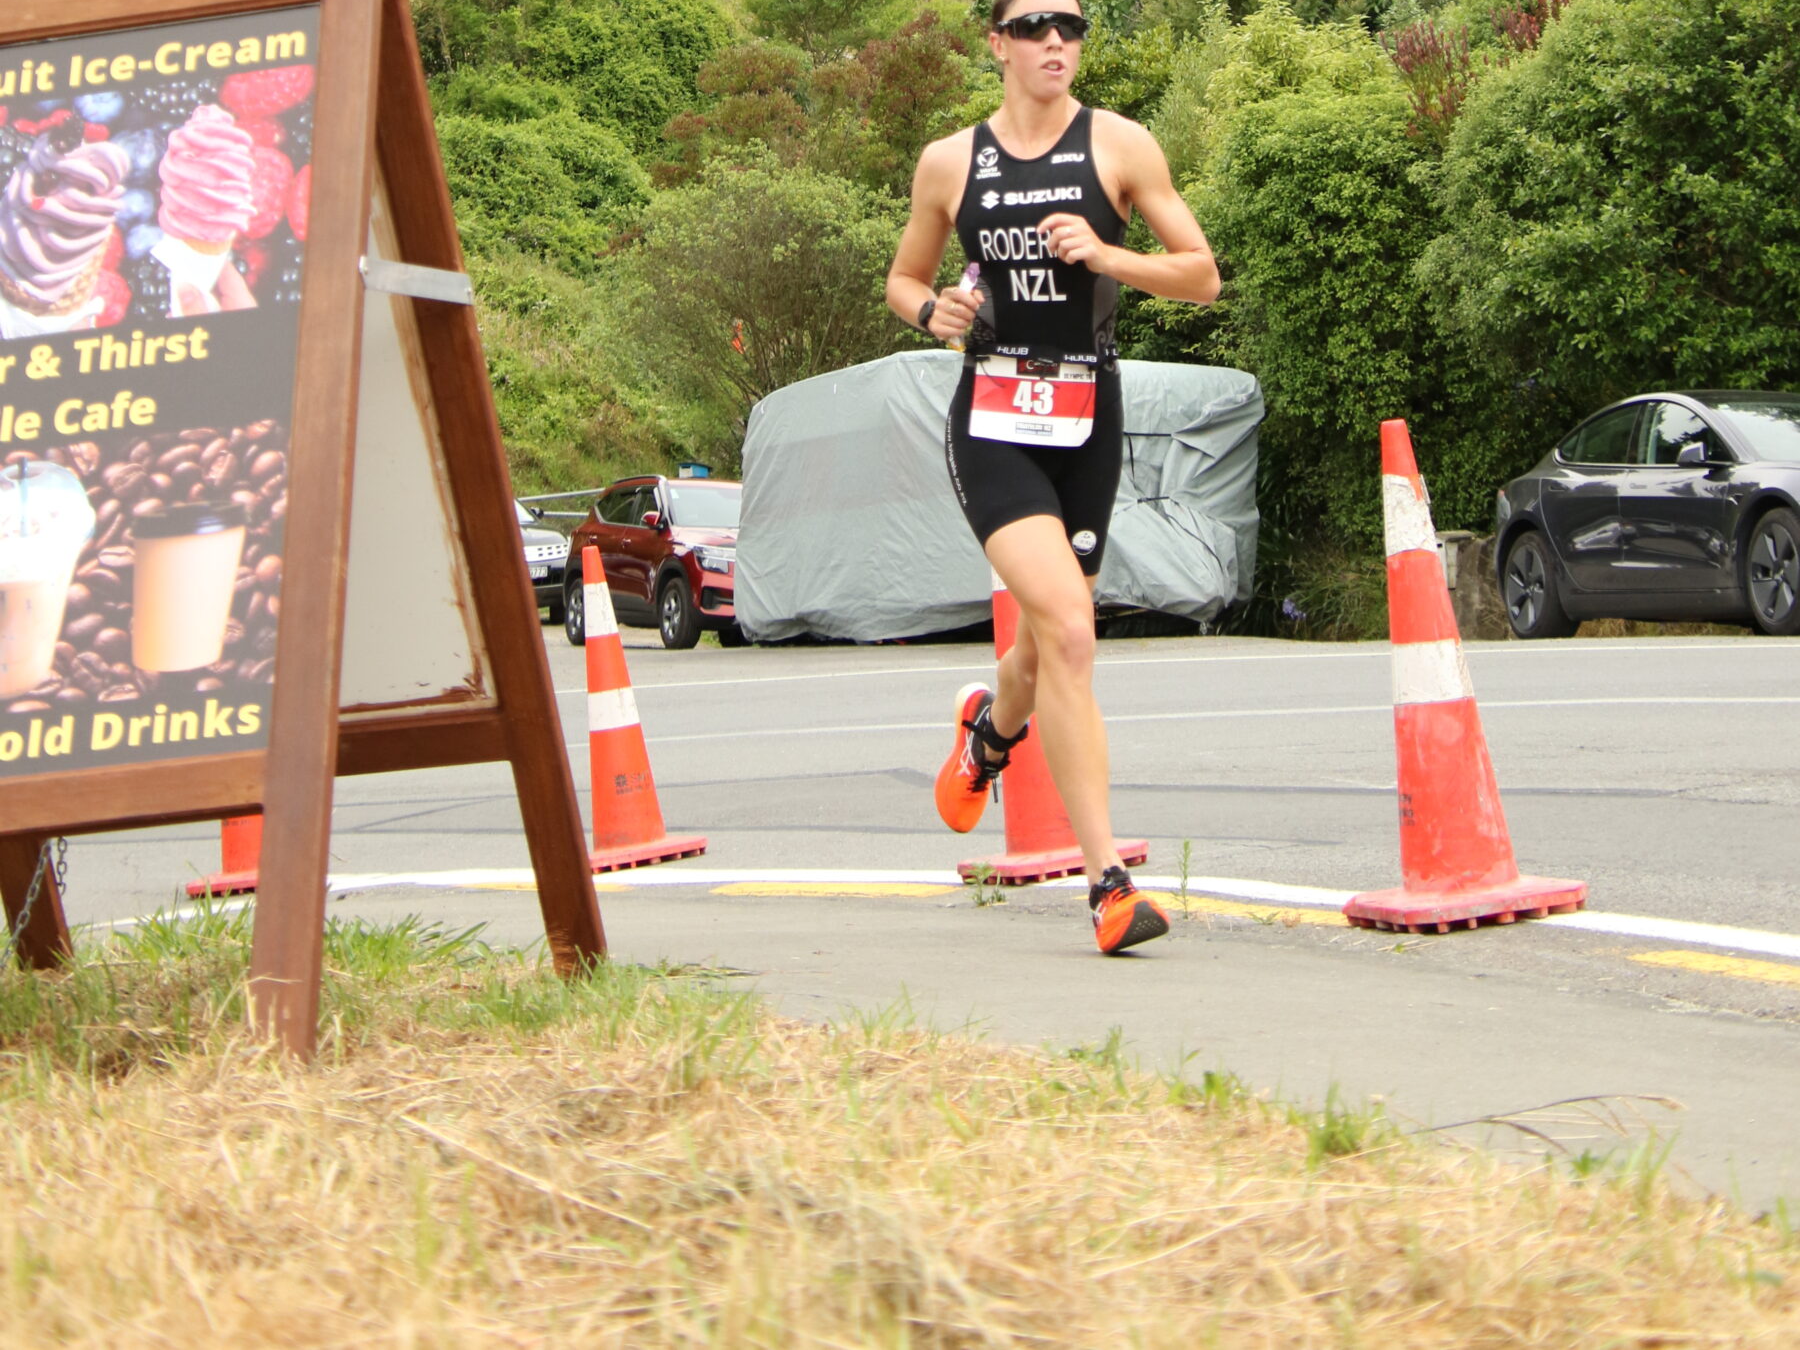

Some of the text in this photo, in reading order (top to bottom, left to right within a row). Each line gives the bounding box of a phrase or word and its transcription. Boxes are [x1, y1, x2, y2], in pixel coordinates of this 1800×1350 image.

[69, 30, 306, 87] Ice-Cream
[1052, 152, 1085, 164] 2XU
[1003, 186, 1083, 206] SUZUKI
[979, 226, 1060, 261] RODER
[1010, 268, 1067, 302] NZL
[25, 344, 61, 380] &
[74, 326, 210, 374] Thirst
[997, 346, 1029, 356] HUUB
[1064, 354, 1098, 364] HUUB
[53, 390, 157, 435] Cafe
[1013, 380, 1054, 415] 43
[90, 699, 261, 751] Drinks
